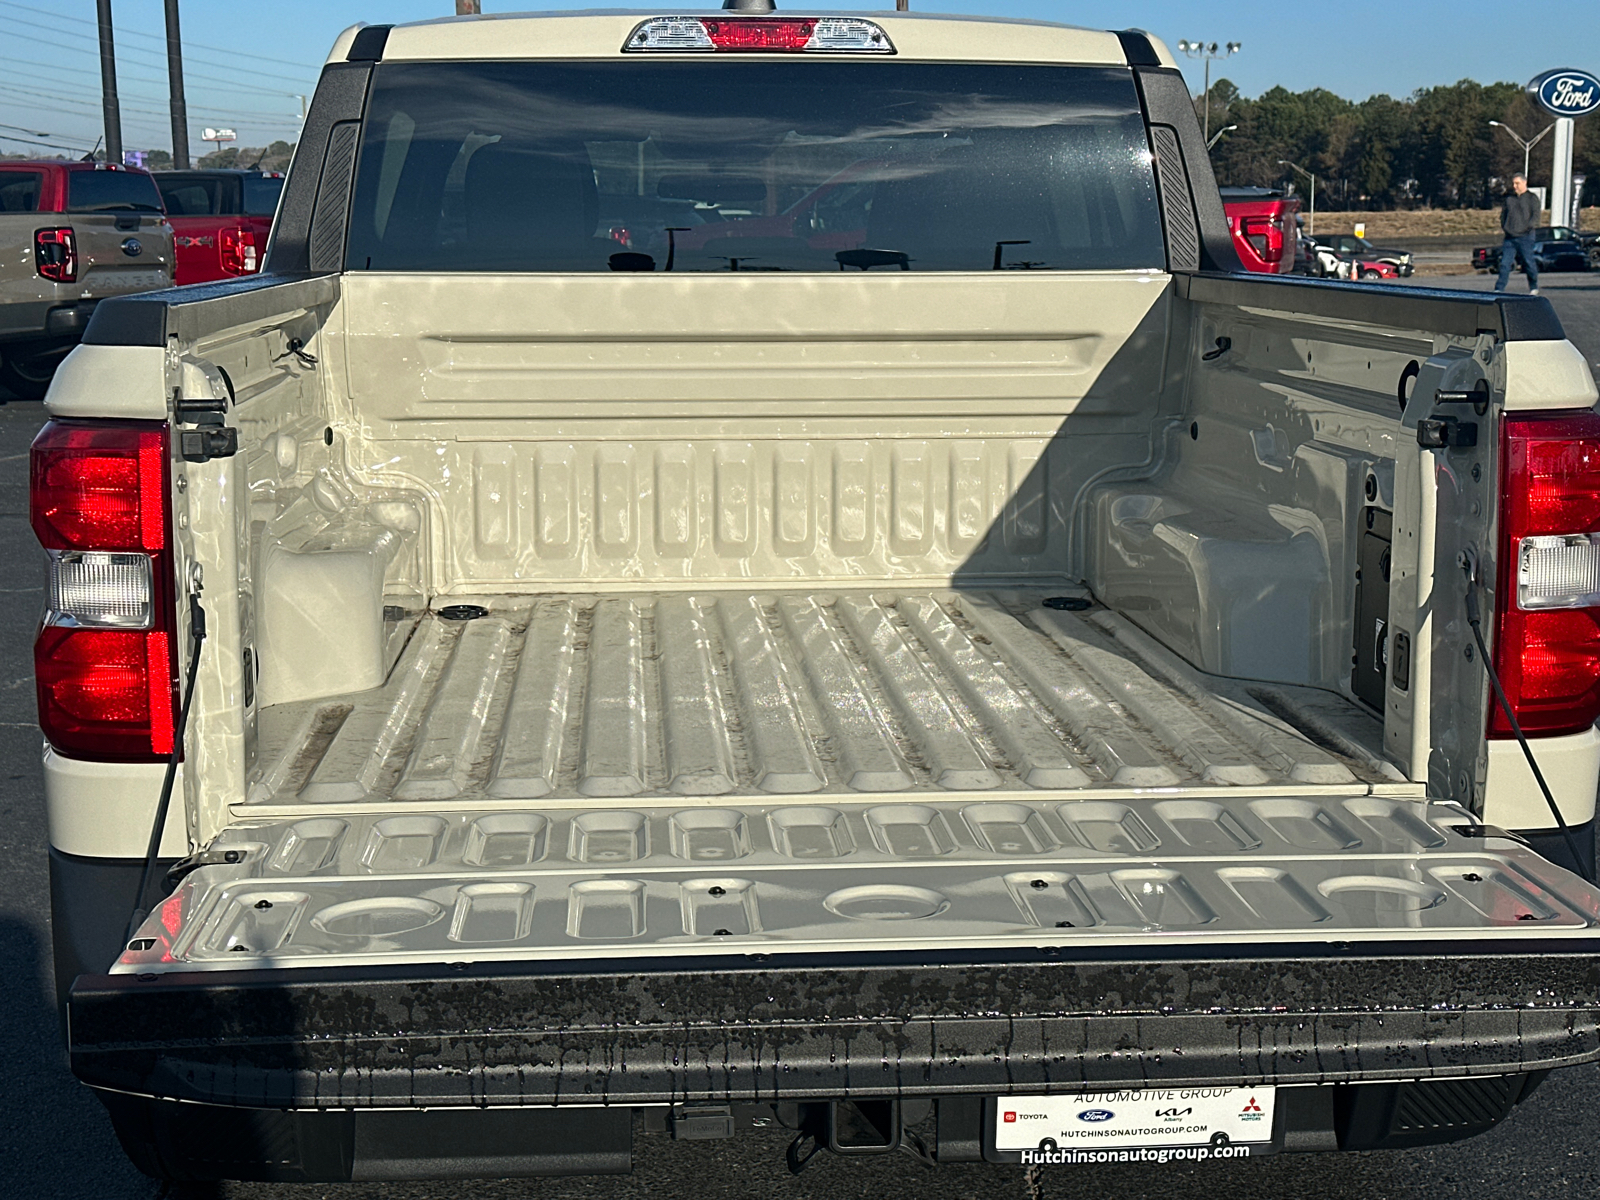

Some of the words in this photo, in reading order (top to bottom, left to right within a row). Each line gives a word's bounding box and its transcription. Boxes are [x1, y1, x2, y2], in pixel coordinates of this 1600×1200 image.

[1551, 77, 1594, 107] Ford
[1073, 1090, 1175, 1104] AUTOMOTIVE
[1180, 1088, 1233, 1100] GROUP
[1083, 1111, 1108, 1120] Ford
[1060, 1125, 1208, 1138] HUTCHINSONAUTOGROUP.COM
[1020, 1145, 1250, 1165] Hutchinsonautogroup.com
